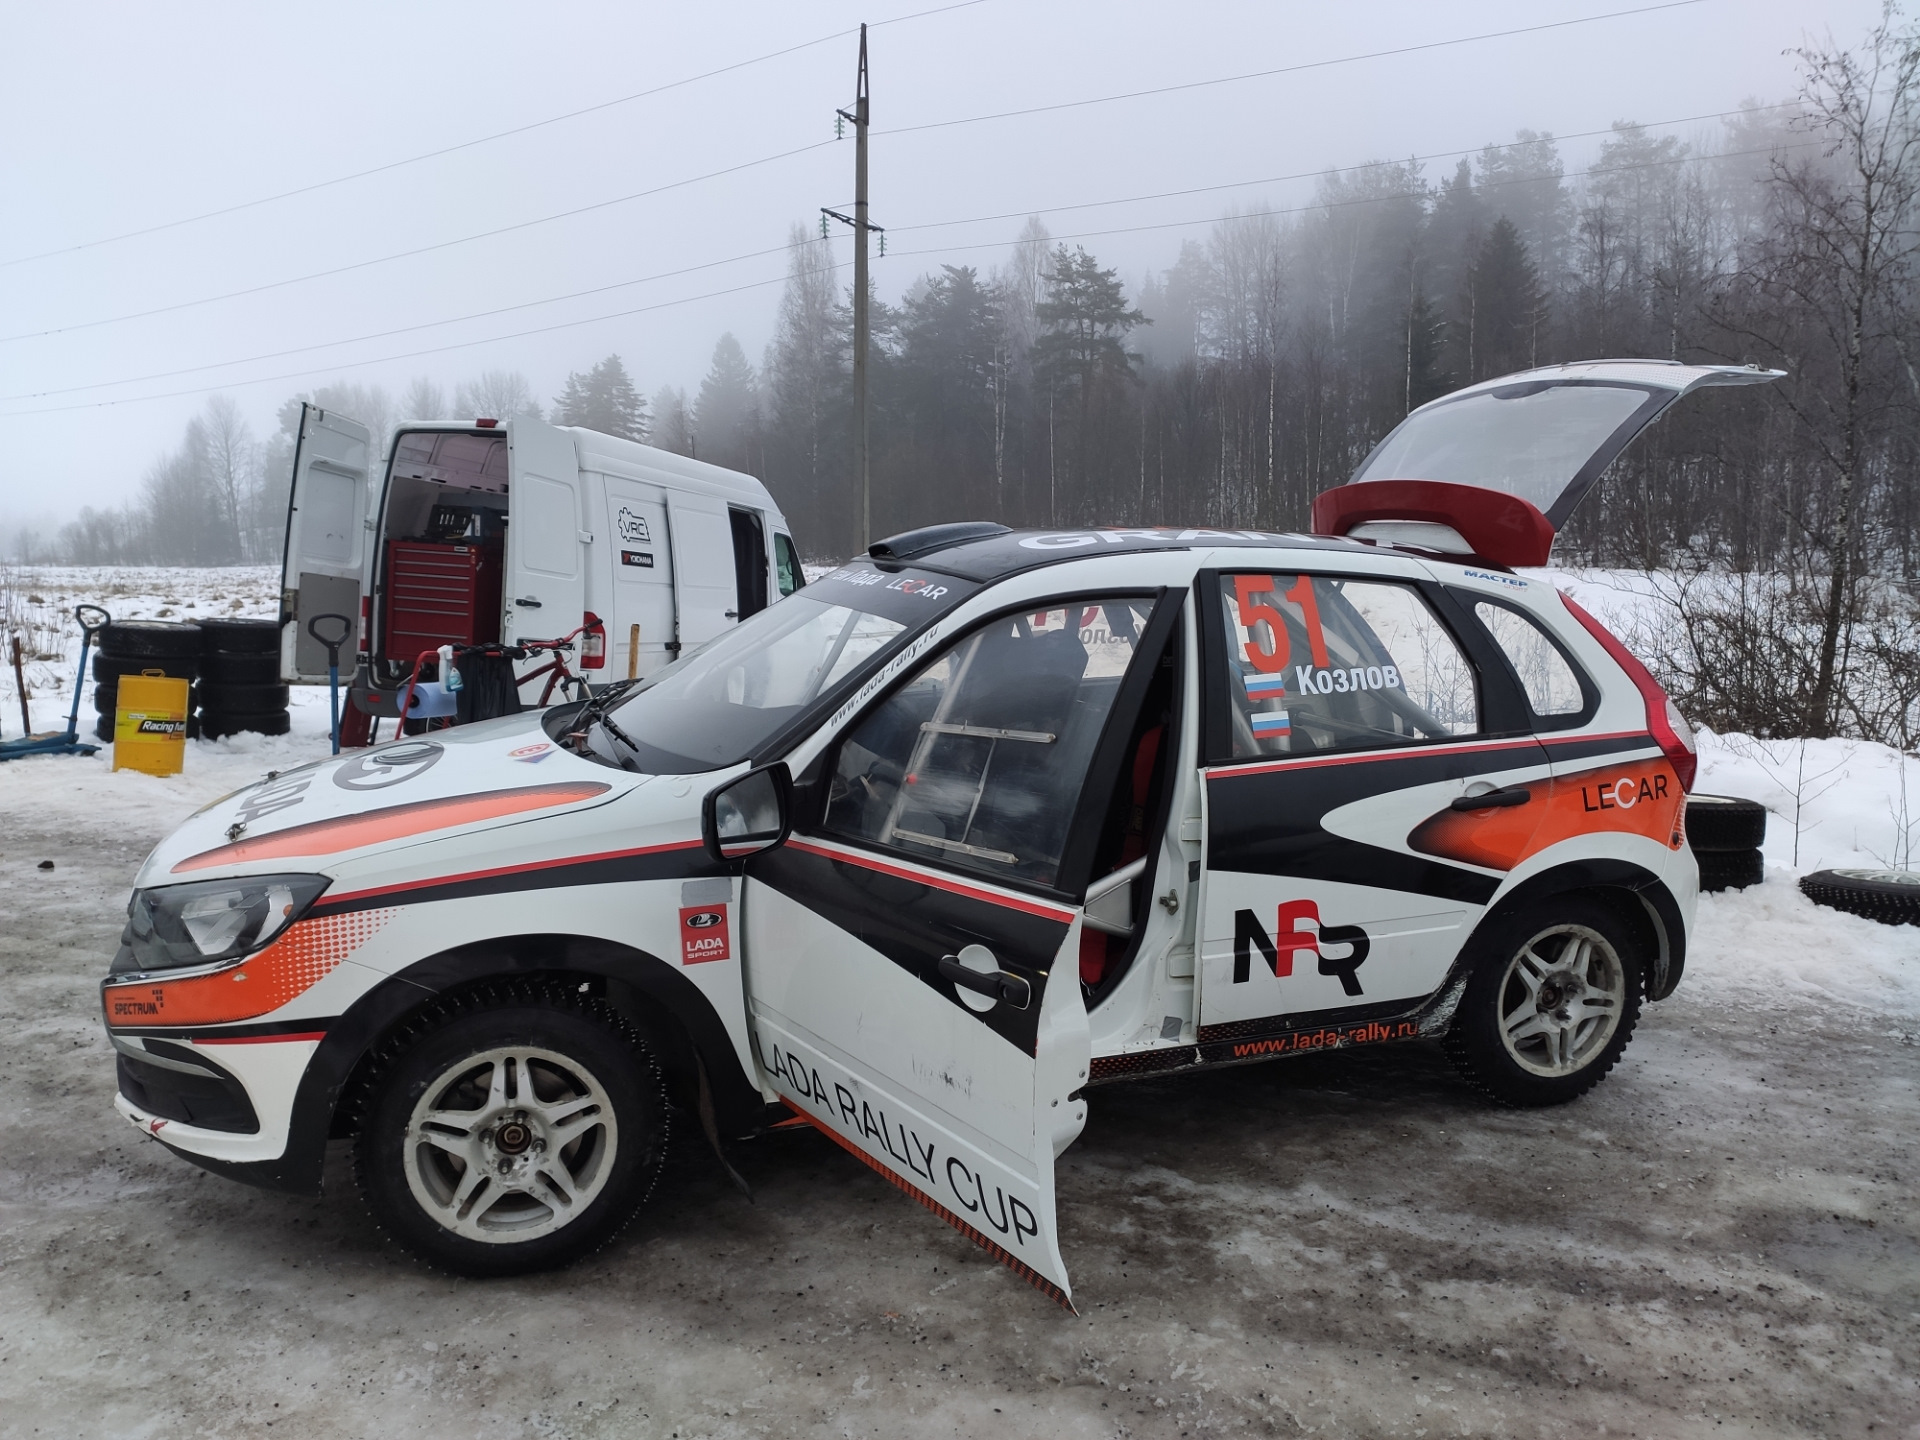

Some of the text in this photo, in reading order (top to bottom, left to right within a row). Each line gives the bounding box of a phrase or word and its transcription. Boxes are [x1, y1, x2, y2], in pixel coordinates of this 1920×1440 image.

[623, 519, 645, 536] VRC
[885, 578, 949, 600] LECAR
[1233, 575, 1331, 673] 51
[830, 624, 940, 728] www.lada-rally.ru
[1296, 664, 1400, 696] Козлов
[142, 721, 174, 733] Racing
[1582, 774, 1668, 812] LECAR
[686, 938, 724, 952] LADA
[687, 949, 725, 959] SPORT
[115, 1002, 159, 1015] SPECTRUM
[1233, 1022, 1419, 1057] www.lada-rally.ru
[755, 1031, 1038, 1246] LADA RALLY CUP
